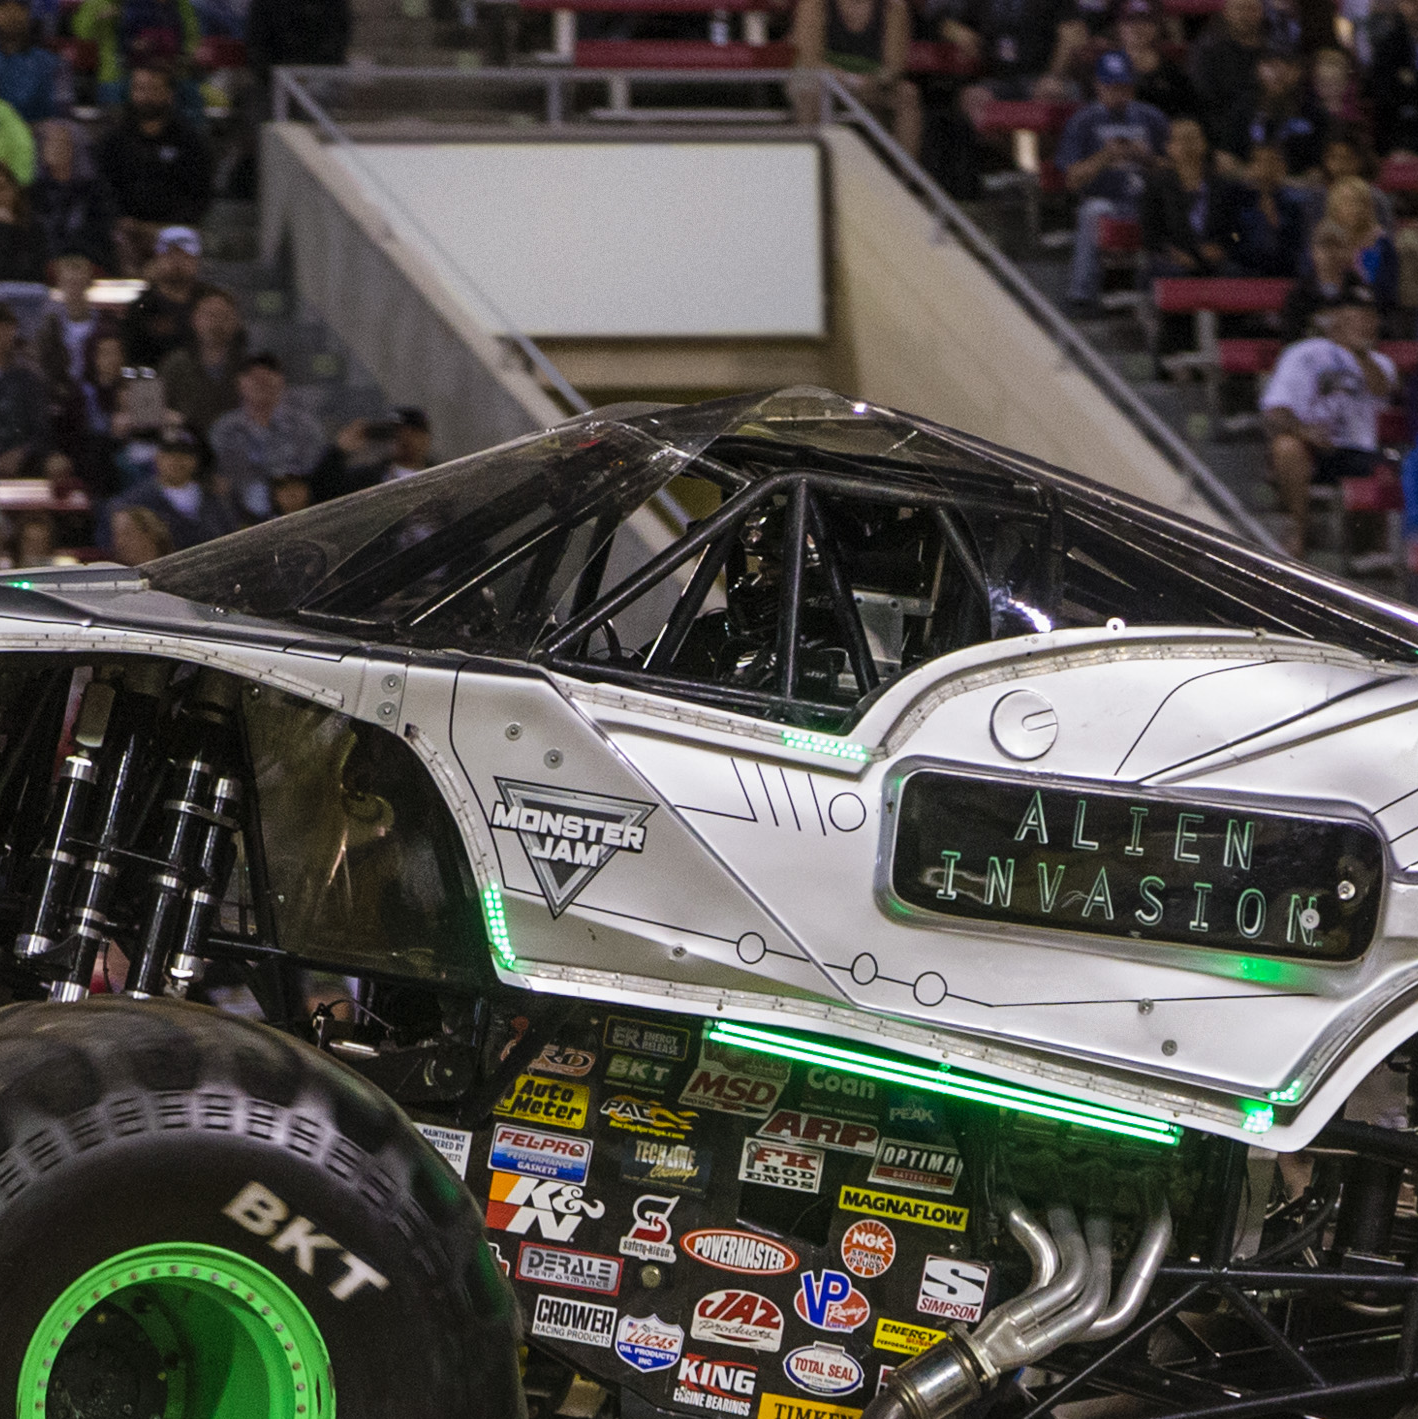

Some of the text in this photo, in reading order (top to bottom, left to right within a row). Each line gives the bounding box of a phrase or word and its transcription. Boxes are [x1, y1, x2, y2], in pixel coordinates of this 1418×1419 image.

[492, 803, 645, 850] MONSTER
[1014, 789, 1255, 870] ALIEN
[532, 836, 602, 867] JAM
[936, 850, 1319, 946] INVASION
[607, 1056, 670, 1083] BKT
[520, 1079, 576, 1103] Auto
[689, 1071, 777, 1105] MSD
[807, 1067, 876, 1099] Coan
[509, 1094, 582, 1121] Meter
[600, 1098, 654, 1123] PAC
[889, 1107, 935, 1124] PEAK
[422, 1127, 466, 1143] MAINTENANCE
[763, 1112, 878, 1148] ARP
[506, 1150, 574, 1170] PERFORMANCE
[516, 1161, 558, 1176] GASKETS
[755, 1148, 818, 1171] FK
[763, 1164, 815, 1180] ROD
[883, 1146, 958, 1175] OPTIMA
[745, 1171, 814, 1190] ENDS
[843, 1190, 964, 1226] MAGNAFLOW
[219, 1181, 390, 1303] BKT
[693, 1235, 786, 1270] POWERMASTER
[852, 1231, 889, 1251] NGK
[527, 1250, 612, 1283] DERALE
[848, 1256, 883, 1271] PLUGS
[851, 1249, 885, 1263] SPARK
[526, 1268, 610, 1288] PERFORMANCE
[801, 1269, 851, 1327] VP
[919, 1299, 978, 1321] SIMPSON
[536, 1298, 615, 1335] CROWER
[697, 1292, 781, 1330] JAZ
[829, 1303, 869, 1323] Racing
[534, 1323, 610, 1346] RACING PRODUCTS
[624, 1331, 679, 1350] LUCAS
[698, 1319, 775, 1341] Products
[881, 1323, 938, 1342] ENERGY
[619, 1344, 676, 1363] OIL PRODUCTS
[638, 1357, 653, 1367] INC
[677, 1358, 757, 1395] KING
[794, 1357, 854, 1382] TOTAL SEAL
[705, 1392, 751, 1417] BEARINGS
